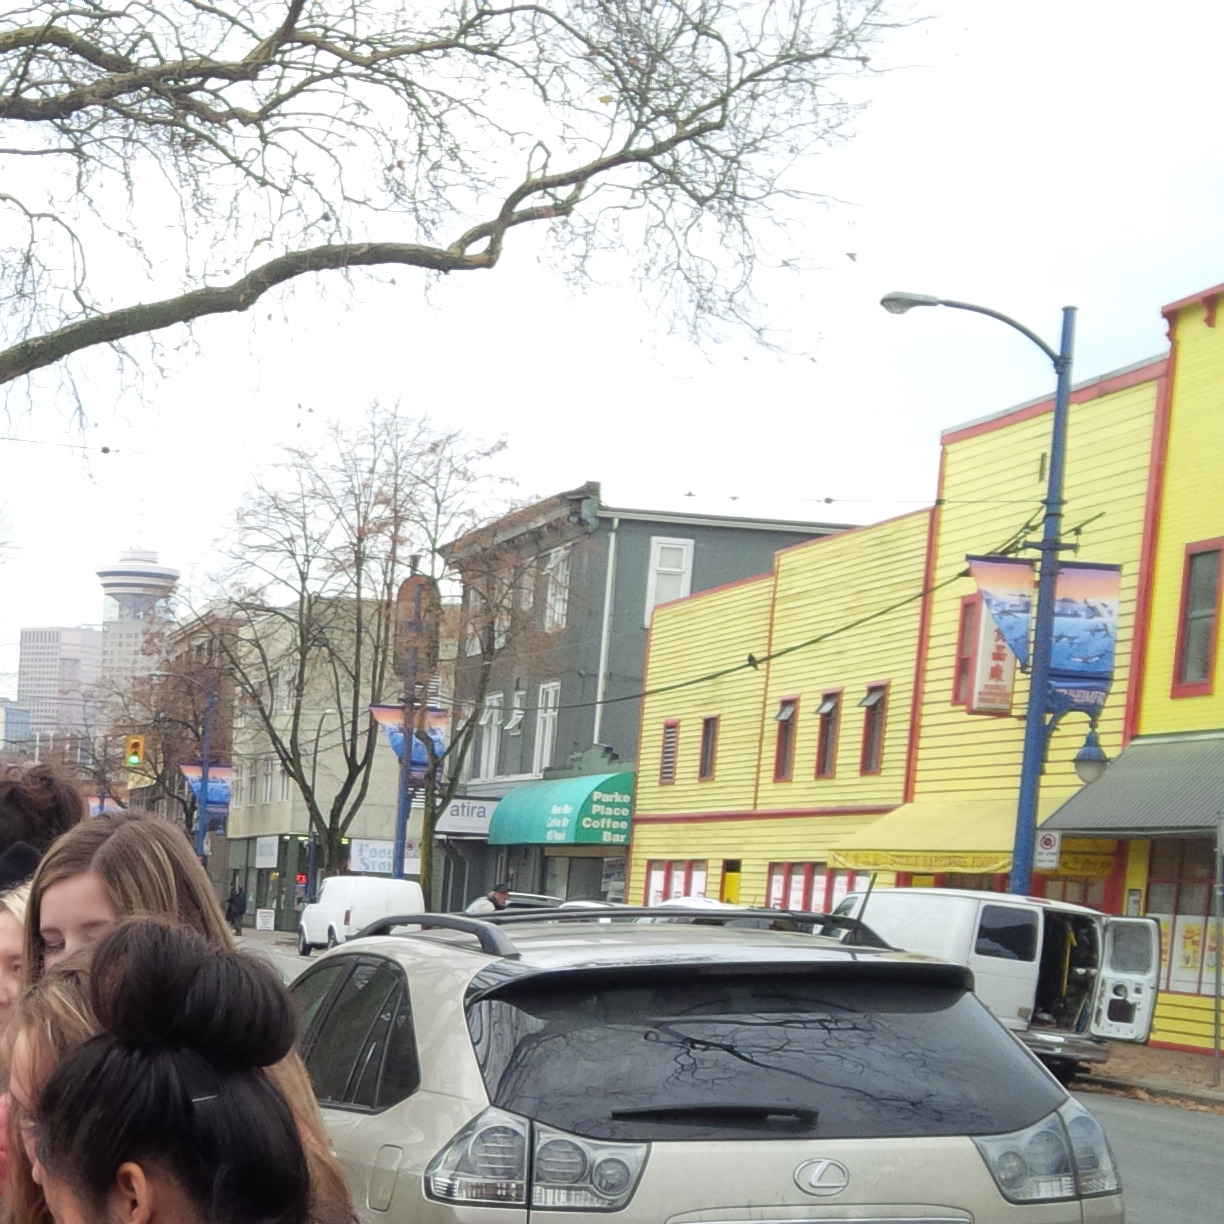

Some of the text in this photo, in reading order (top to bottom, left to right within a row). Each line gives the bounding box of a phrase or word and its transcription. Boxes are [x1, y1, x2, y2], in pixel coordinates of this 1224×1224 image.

[592, 791, 631, 803] Parke
[449, 802, 487, 819] atira
[591, 804, 630, 816] Place
[581, 817, 629, 830] Coffee
[602, 831, 627, 842] Bar
